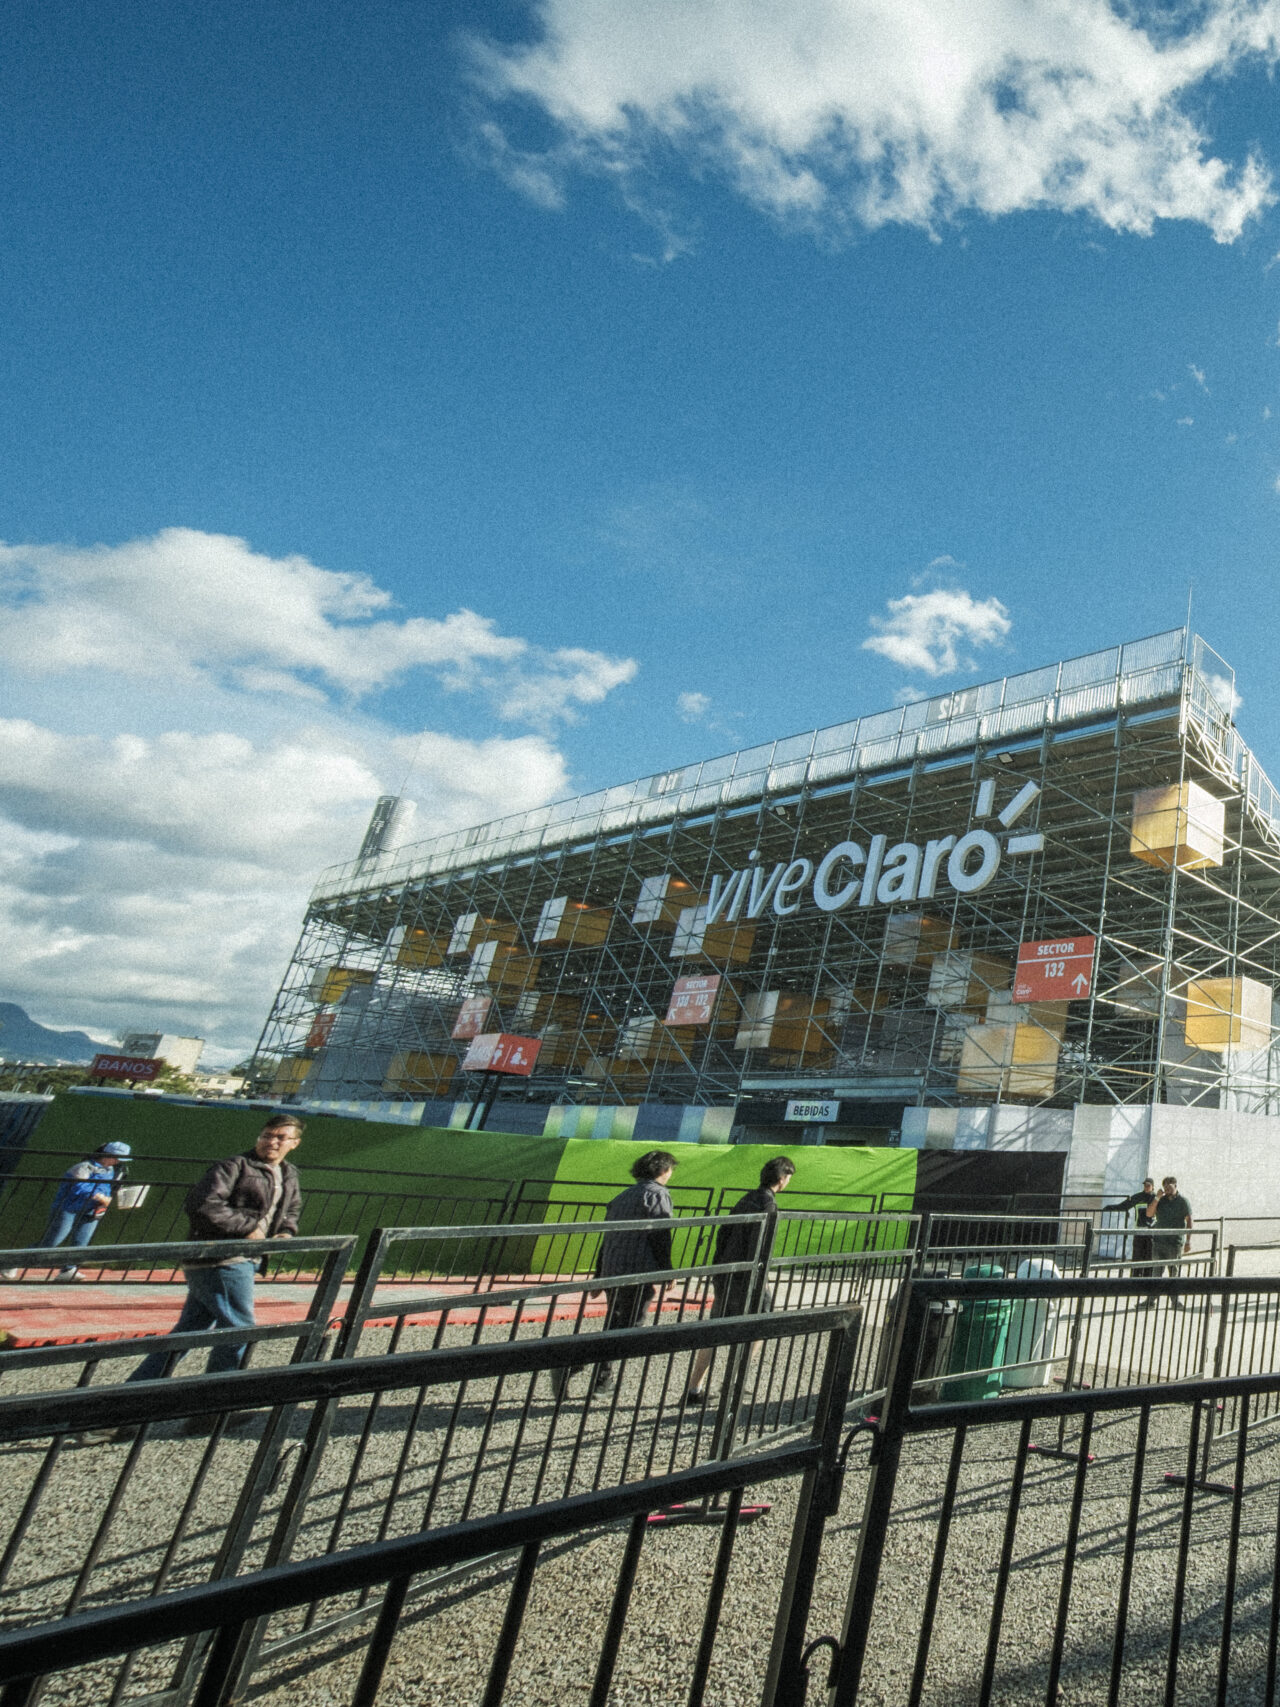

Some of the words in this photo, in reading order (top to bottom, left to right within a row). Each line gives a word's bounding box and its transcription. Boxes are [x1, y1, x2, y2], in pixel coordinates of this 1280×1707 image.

[1037, 943, 1075, 956] SECTOR
[1045, 961, 1065, 978] 132
[793, 1105, 829, 1117] BEBIDAS
